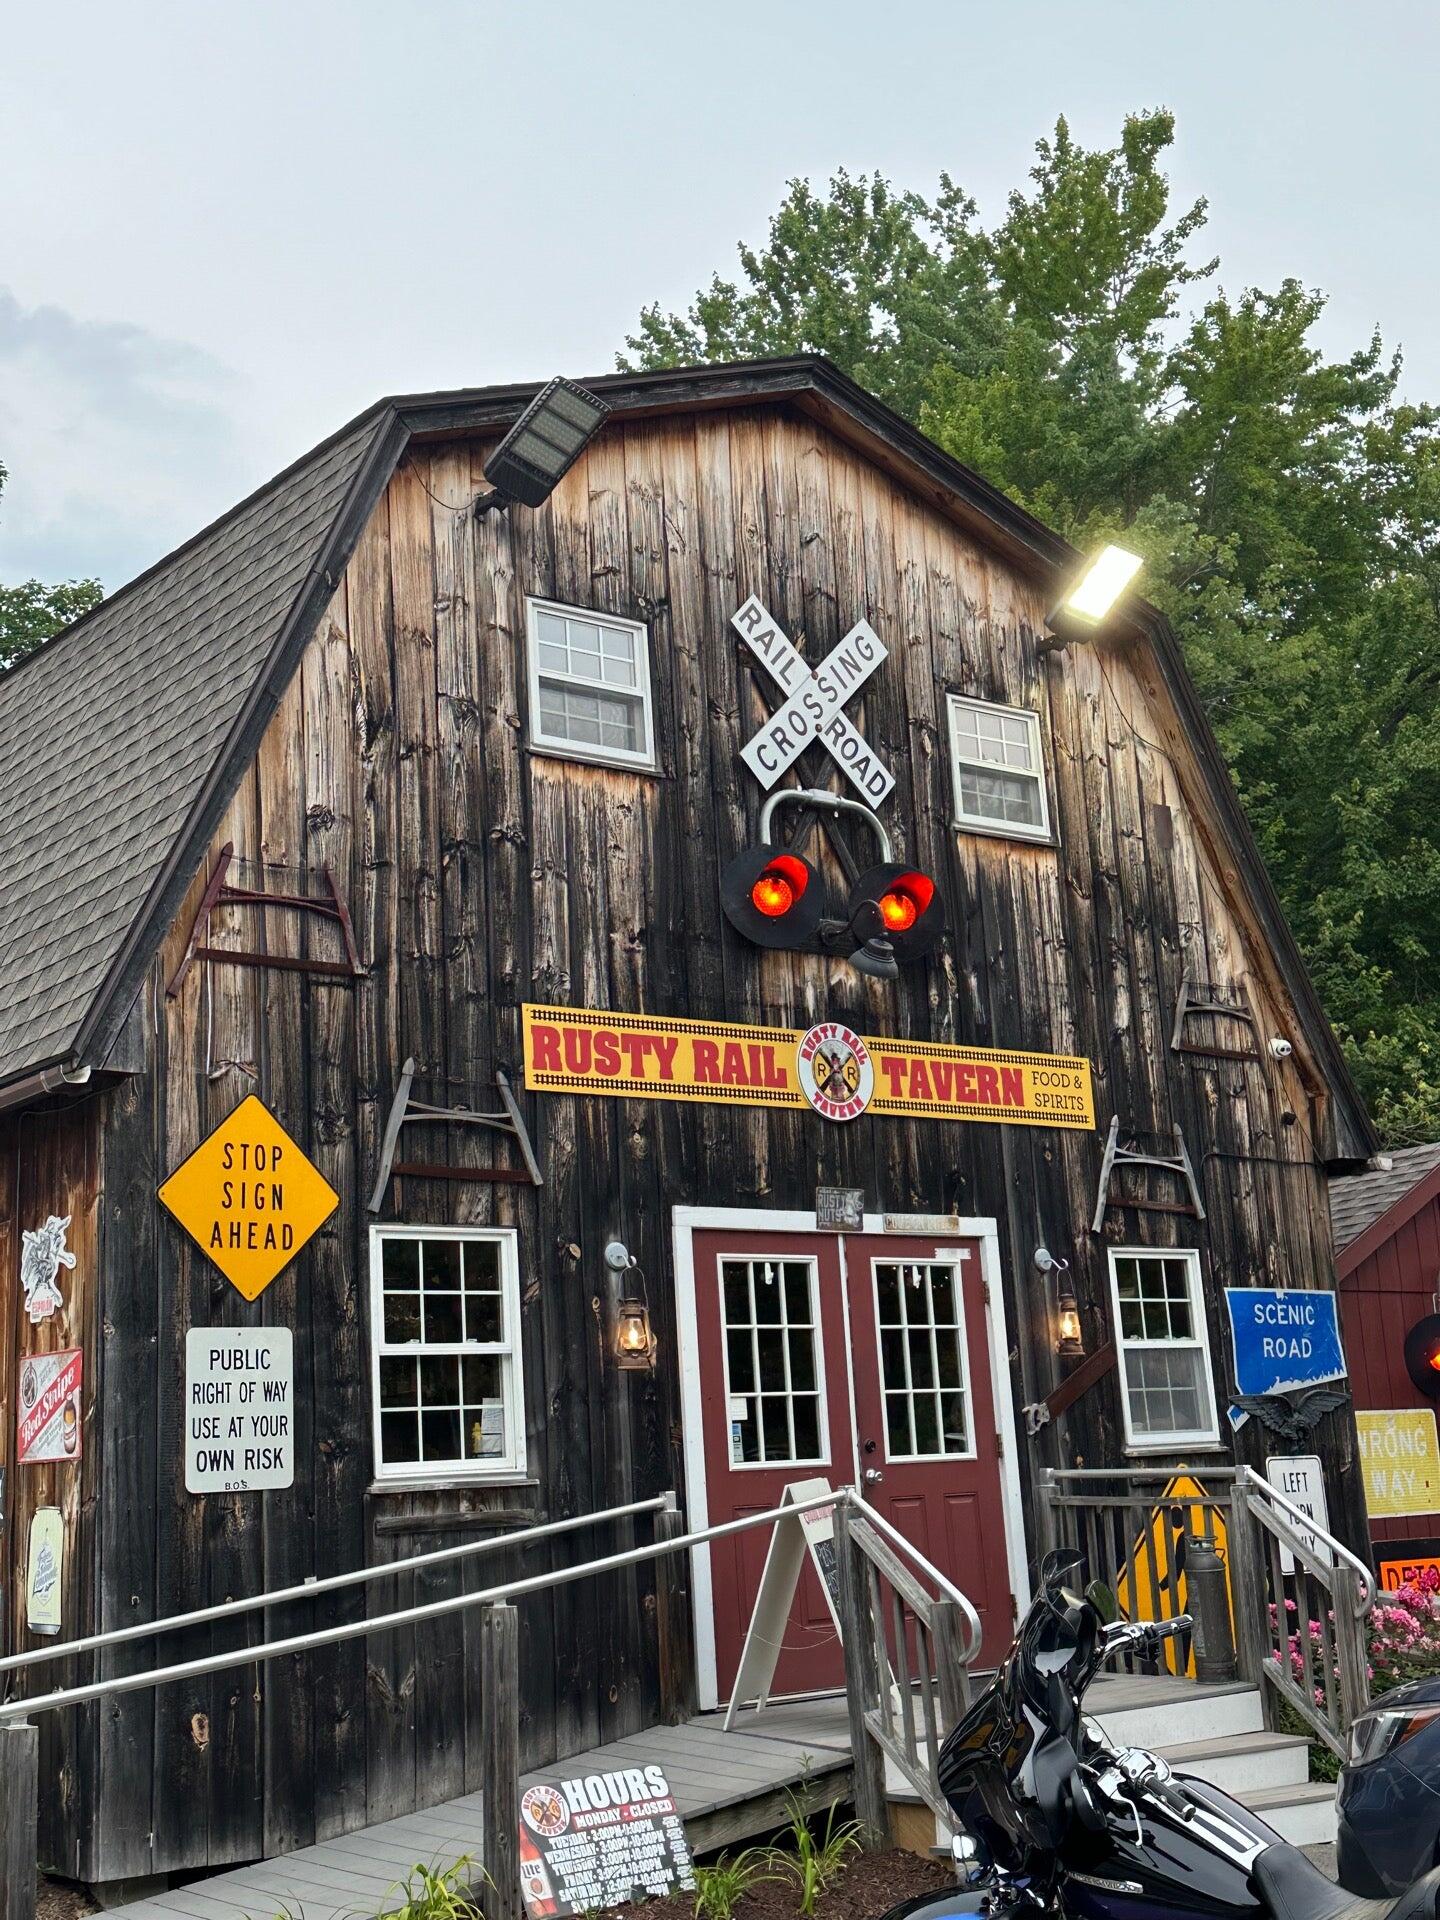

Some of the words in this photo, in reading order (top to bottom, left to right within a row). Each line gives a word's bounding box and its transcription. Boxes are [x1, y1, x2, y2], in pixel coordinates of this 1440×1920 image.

[738, 603, 796, 687] RAIL
[757, 635, 874, 772] CROSSING
[824, 716, 887, 797] ROAD
[531, 1025, 678, 1080] RUSTY
[692, 1039, 787, 1088] RAIL
[801, 1025, 838, 1061] RUSTY
[841, 1029, 868, 1066] RAIL
[817, 1063, 827, 1077] R
[847, 1067, 857, 1080] R
[881, 1057, 1025, 1107] TAVERN
[1032, 1071, 1071, 1088] FOOD
[1074, 1075, 1083, 1089] &
[813, 1091, 865, 1117] TAVERN
[1034, 1093, 1084, 1111] SPIRITS
[222, 1143, 283, 1171] STOP
[222, 1181, 283, 1210] SIGN
[210, 1221, 293, 1250] AHEAD
[1254, 1304, 1315, 1325] SCENIC
[209, 1348, 271, 1370] PUBLIC
[1263, 1337, 1312, 1358] ROAD
[192, 1382, 232, 1404] RIGHT
[239, 1381, 256, 1403] OF
[263, 1381, 288, 1402] WAY
[22, 1406, 43, 1448] Red
[42, 1366, 75, 1418] Stripe
[192, 1417, 220, 1439] USE
[228, 1416, 244, 1438] AT
[251, 1415, 288, 1437] YOUR
[1358, 1428, 1427, 1457] WRONG
[196, 1449, 234, 1472] OWN
[244, 1447, 283, 1470] RISK
[1283, 1472, 1308, 1493] LEFT
[1371, 1469, 1416, 1498] WAY
[561, 1766, 669, 1813] HOURS
[575, 1808, 621, 1829] MONDAY
[630, 1800, 672, 1817] CLOSED
[521, 1864, 541, 1878] Lite
